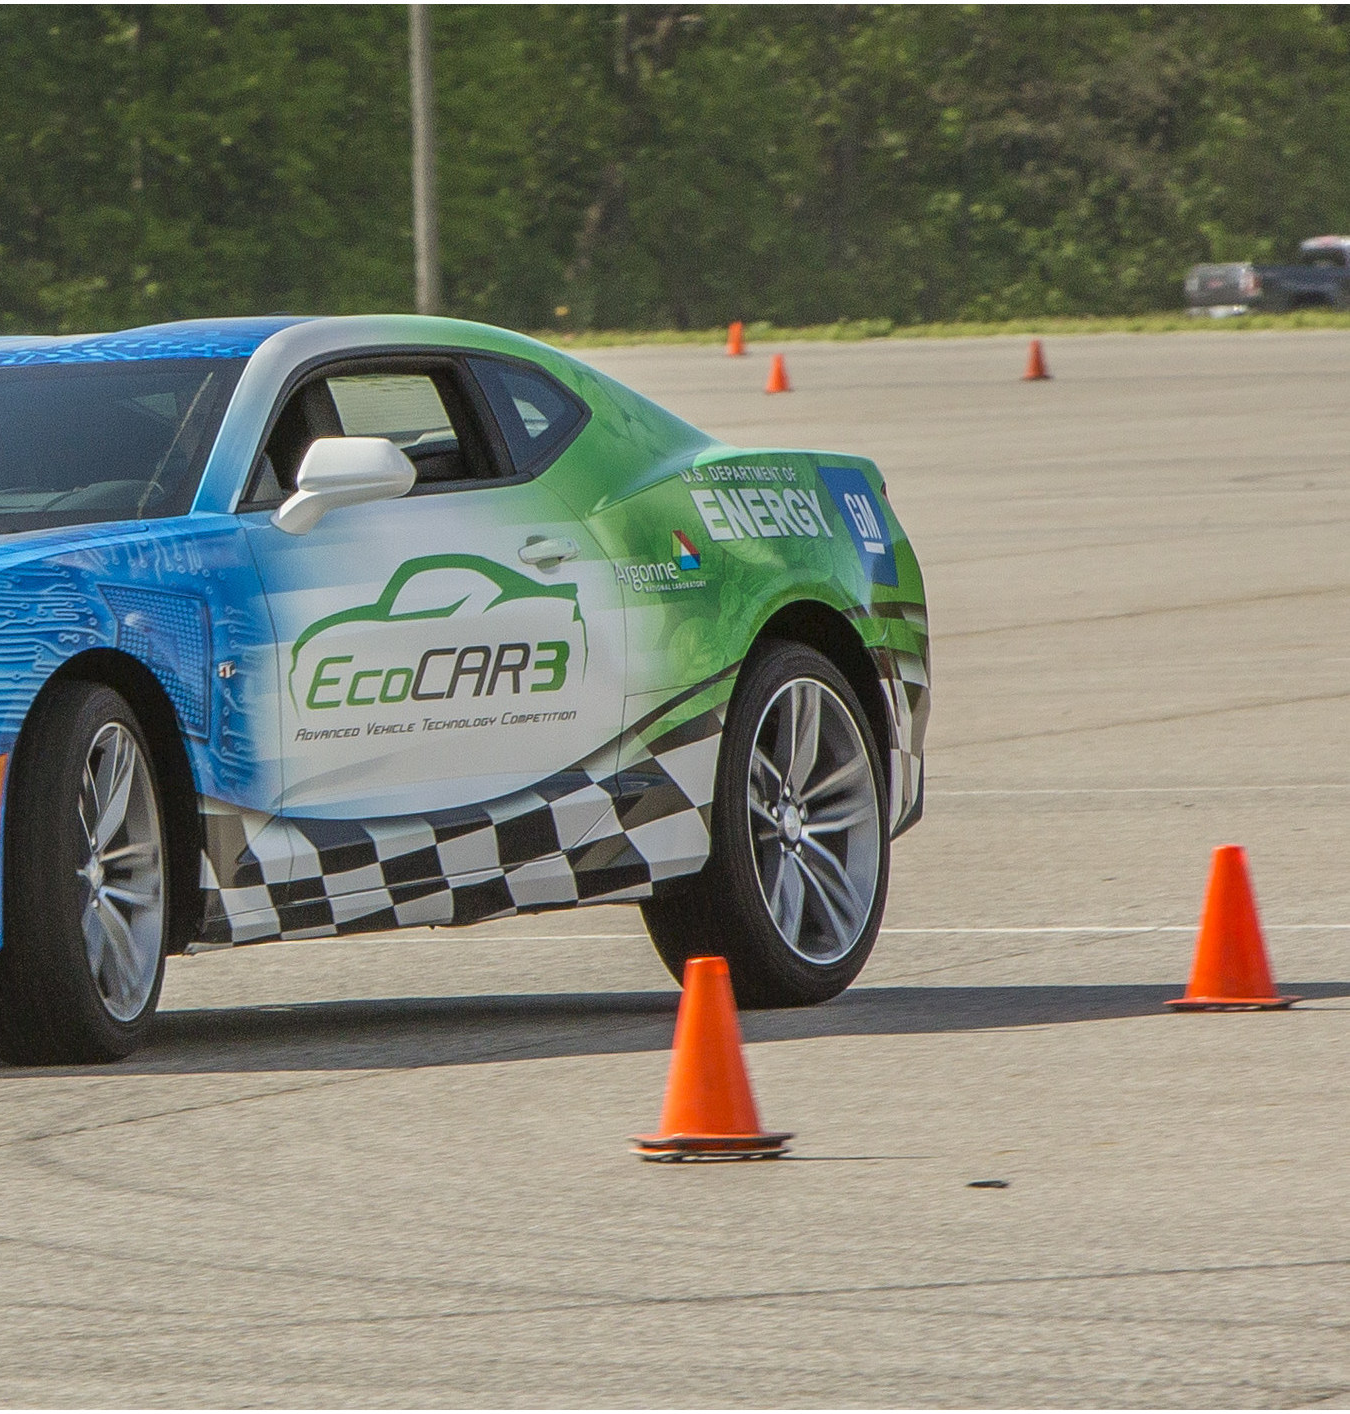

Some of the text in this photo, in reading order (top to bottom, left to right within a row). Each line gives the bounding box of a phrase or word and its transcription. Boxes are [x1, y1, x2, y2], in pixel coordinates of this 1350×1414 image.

[681, 465, 797, 483] U.S. DEPARTMENT OF
[690, 489, 833, 541] ENERGY
[844, 493, 882, 540] GM
[613, 562, 679, 592] Argonne
